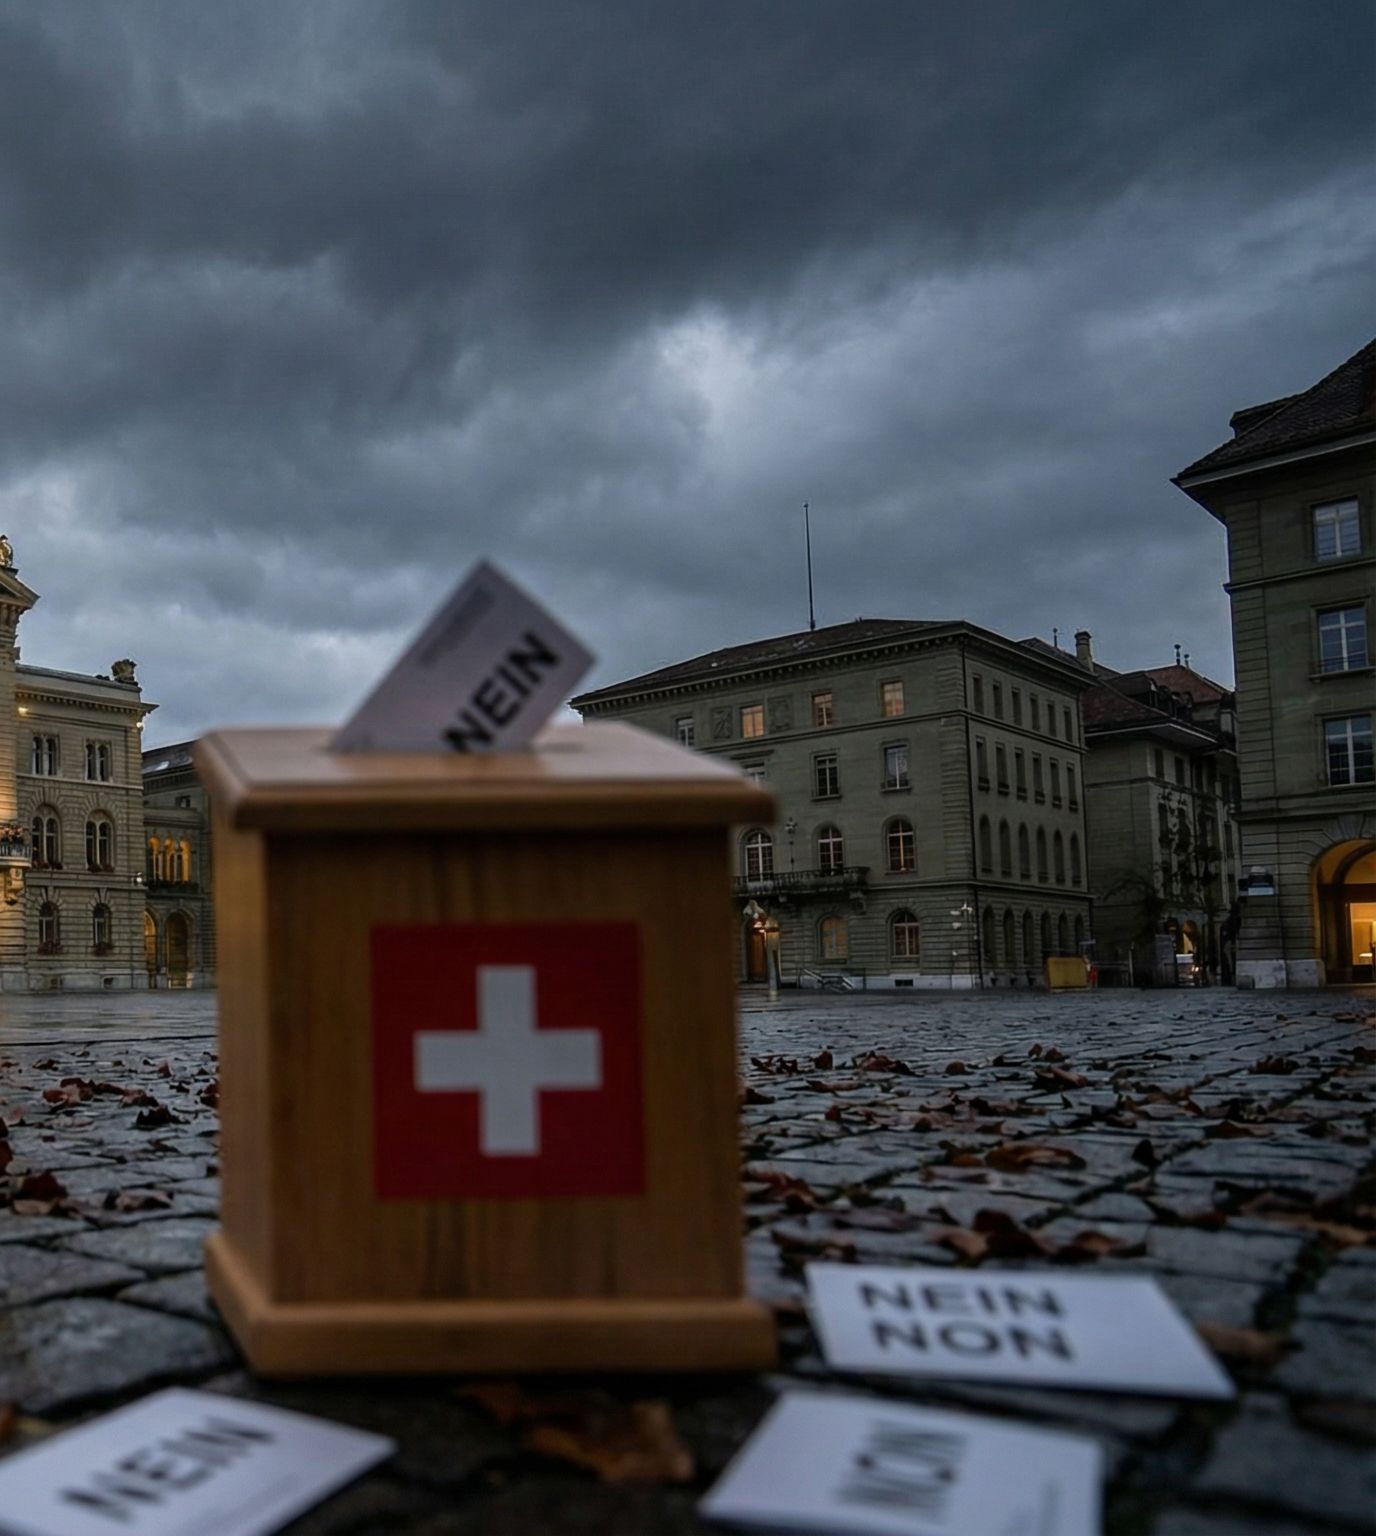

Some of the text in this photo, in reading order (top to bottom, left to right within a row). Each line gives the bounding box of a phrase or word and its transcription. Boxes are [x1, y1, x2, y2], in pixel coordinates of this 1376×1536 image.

[443, 632, 561, 753] NEIN
[859, 1282, 1064, 1317] NEIN
[871, 1319, 1074, 1361] NON
[61, 1416, 275, 1523] NEIN
